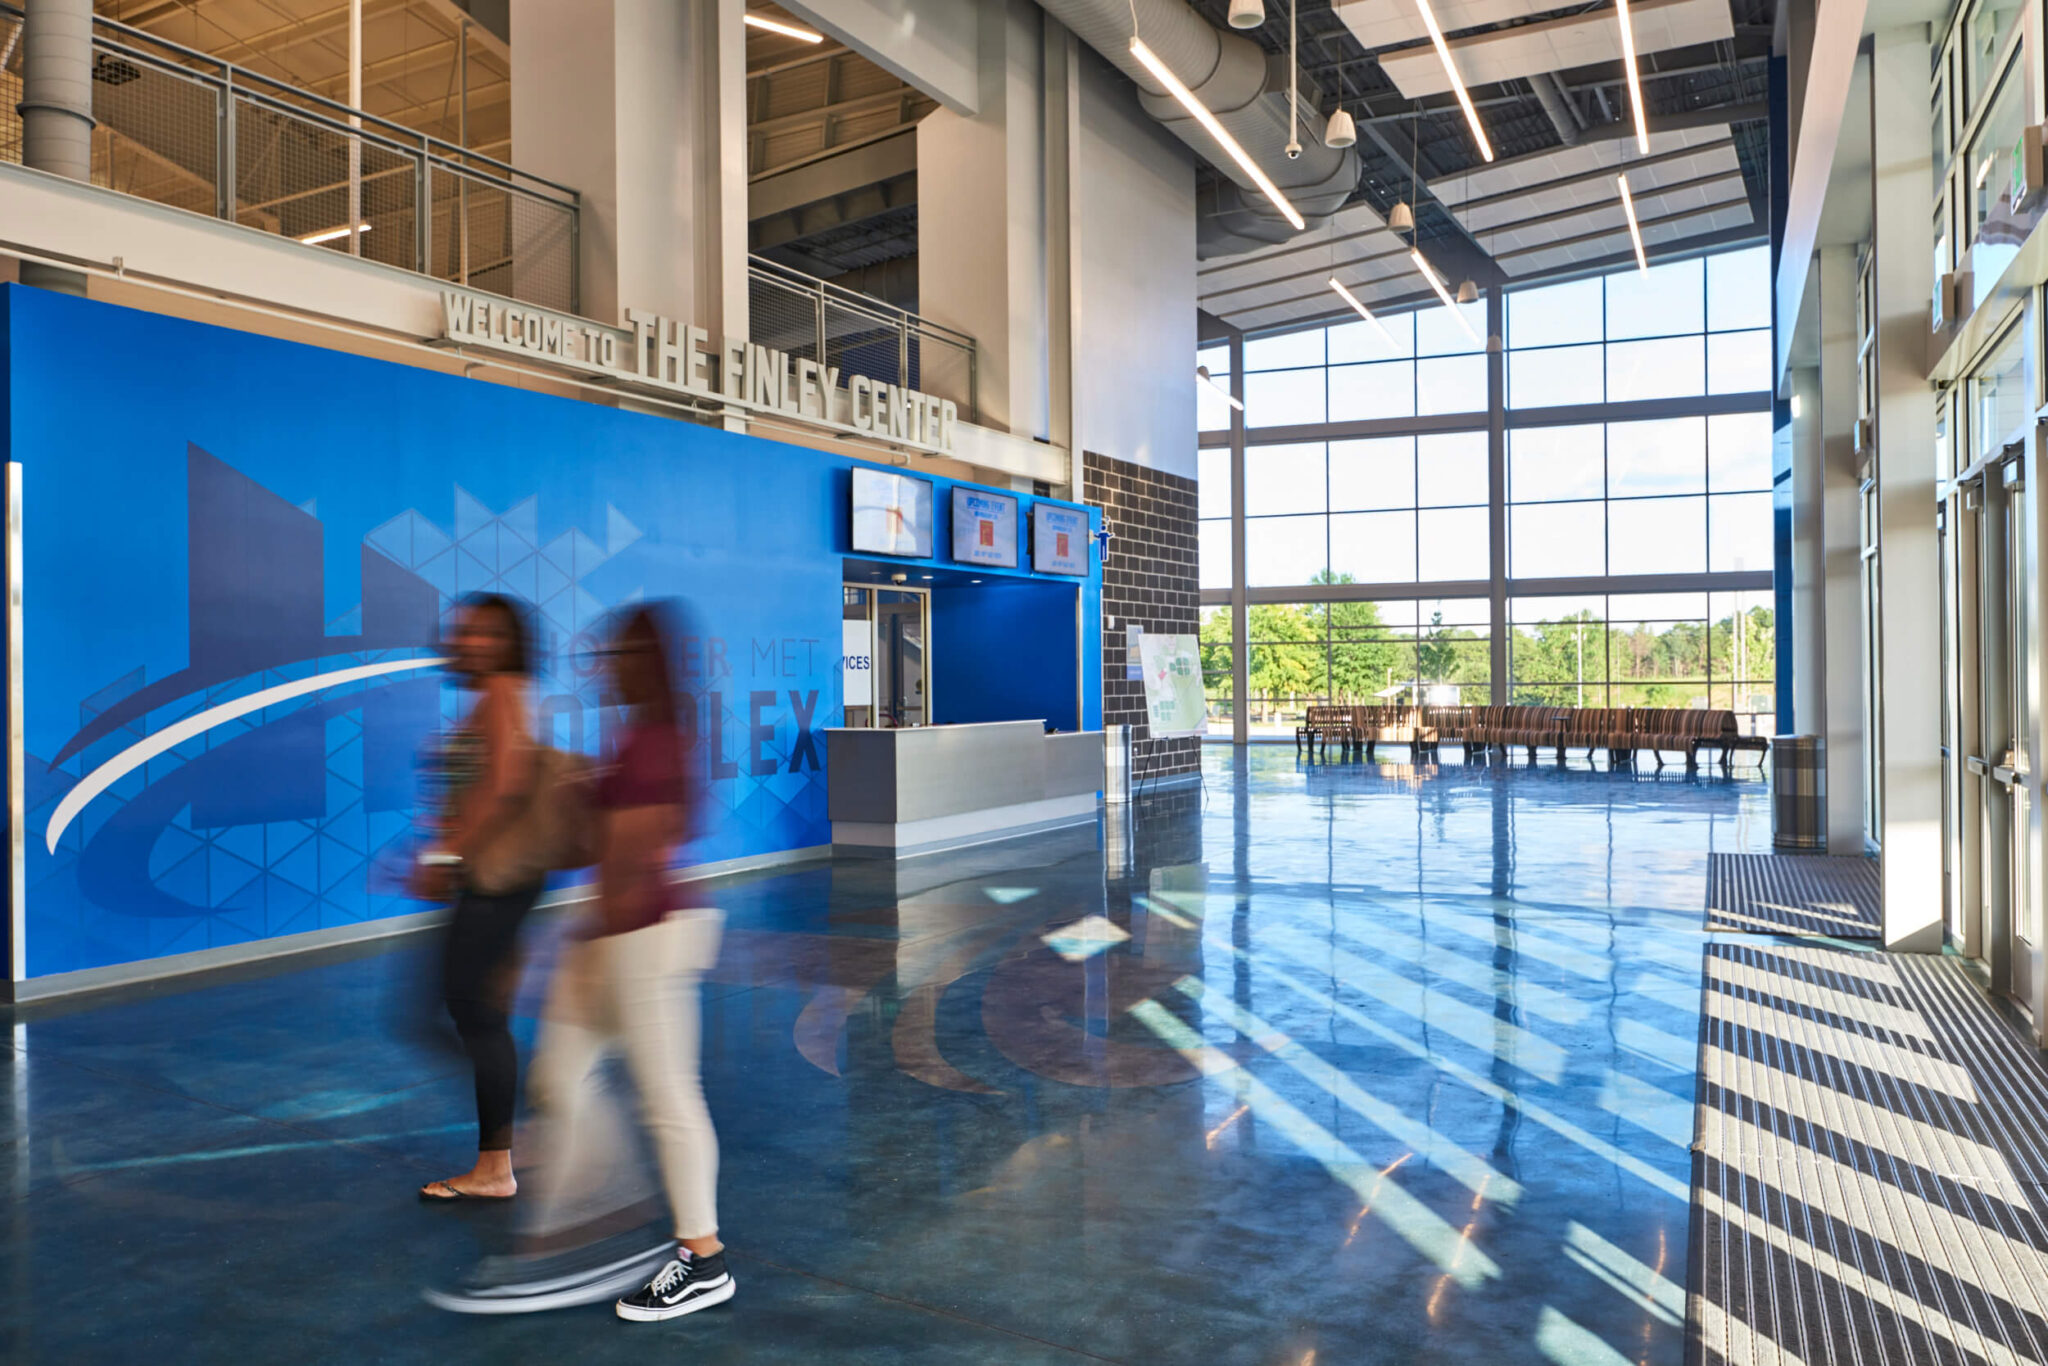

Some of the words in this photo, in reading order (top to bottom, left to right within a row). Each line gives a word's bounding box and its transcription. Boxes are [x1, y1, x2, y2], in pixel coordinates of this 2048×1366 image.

[441, 291, 576, 359] WELCOME
[582, 328, 617, 367] TO
[625, 307, 710, 393] THE
[723, 335, 840, 422] FINLEY
[848, 374, 958, 452] CENTER
[752, 637, 819, 678] MET
